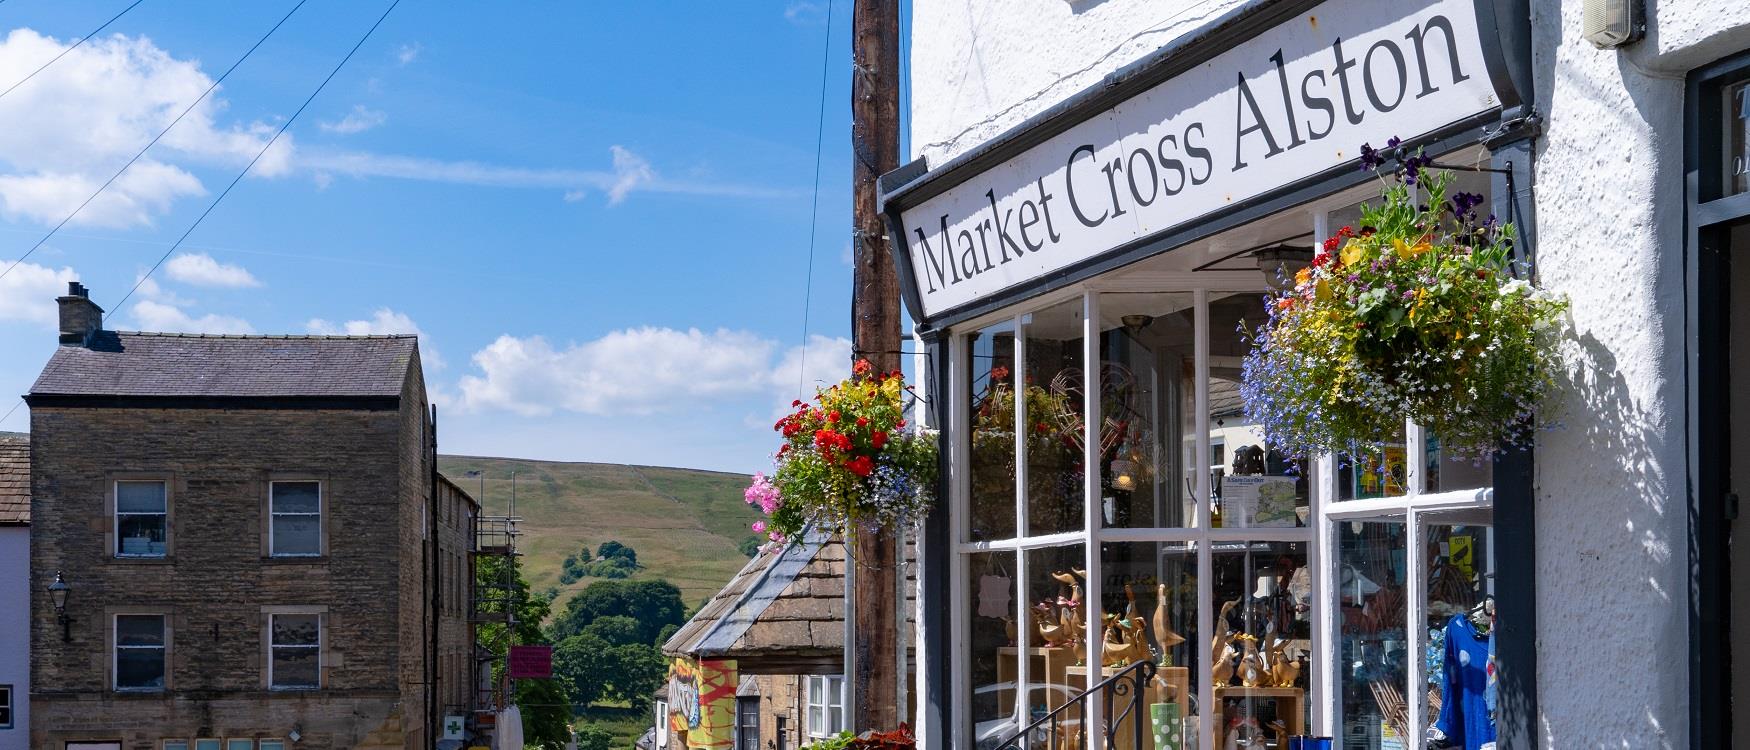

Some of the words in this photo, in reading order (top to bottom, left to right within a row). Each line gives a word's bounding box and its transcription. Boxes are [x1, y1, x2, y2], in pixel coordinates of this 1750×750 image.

[914, 175, 1061, 295] Market
[1065, 122, 1213, 228] Cross
[1231, 15, 1470, 173] Alston
